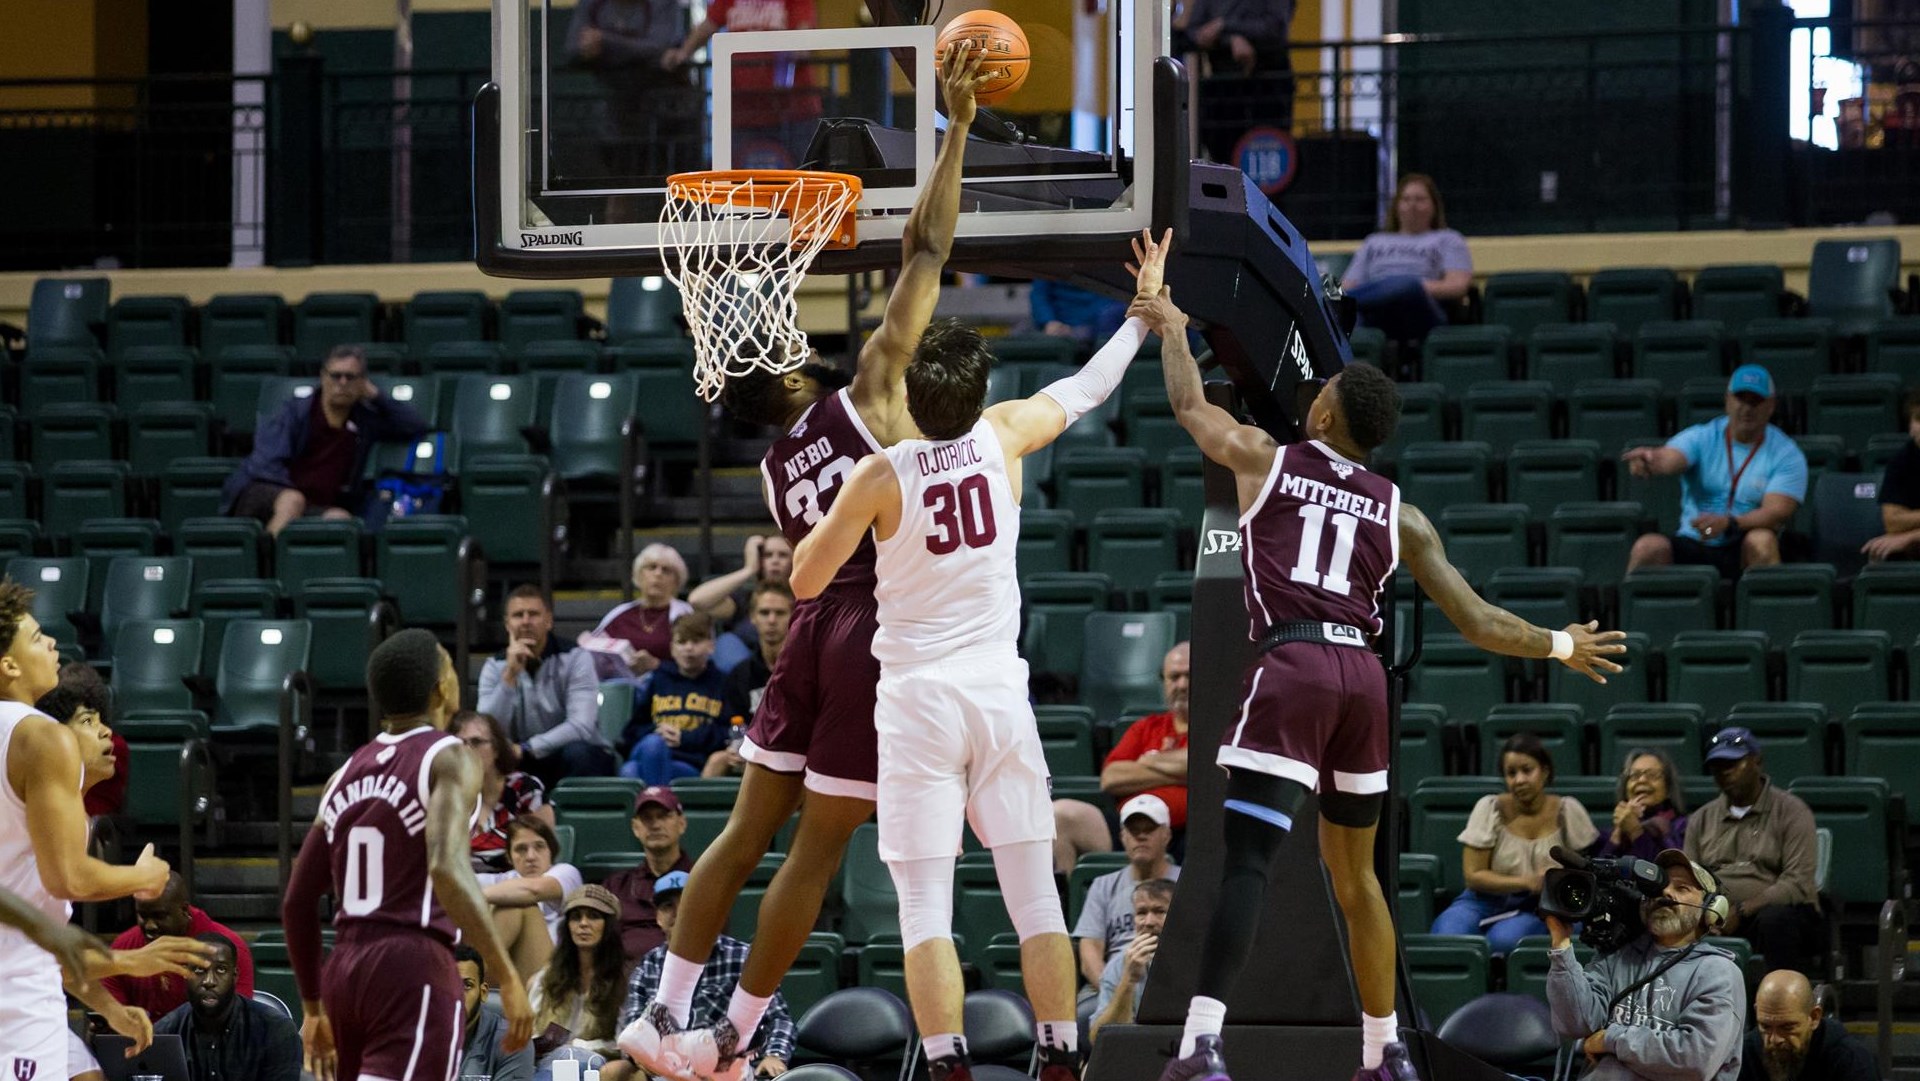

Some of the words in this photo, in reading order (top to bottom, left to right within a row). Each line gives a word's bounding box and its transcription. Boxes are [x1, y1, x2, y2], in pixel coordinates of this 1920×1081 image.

[521, 231, 583, 248] SPALDING
[784, 436, 834, 483] NEBO
[917, 438, 983, 477] DJURICIC
[922, 473, 998, 556] 30
[1278, 473, 1388, 527] MITCHELL
[1289, 502, 1359, 597] 11
[398, 798, 427, 837] III
[342, 825, 385, 917] 0
